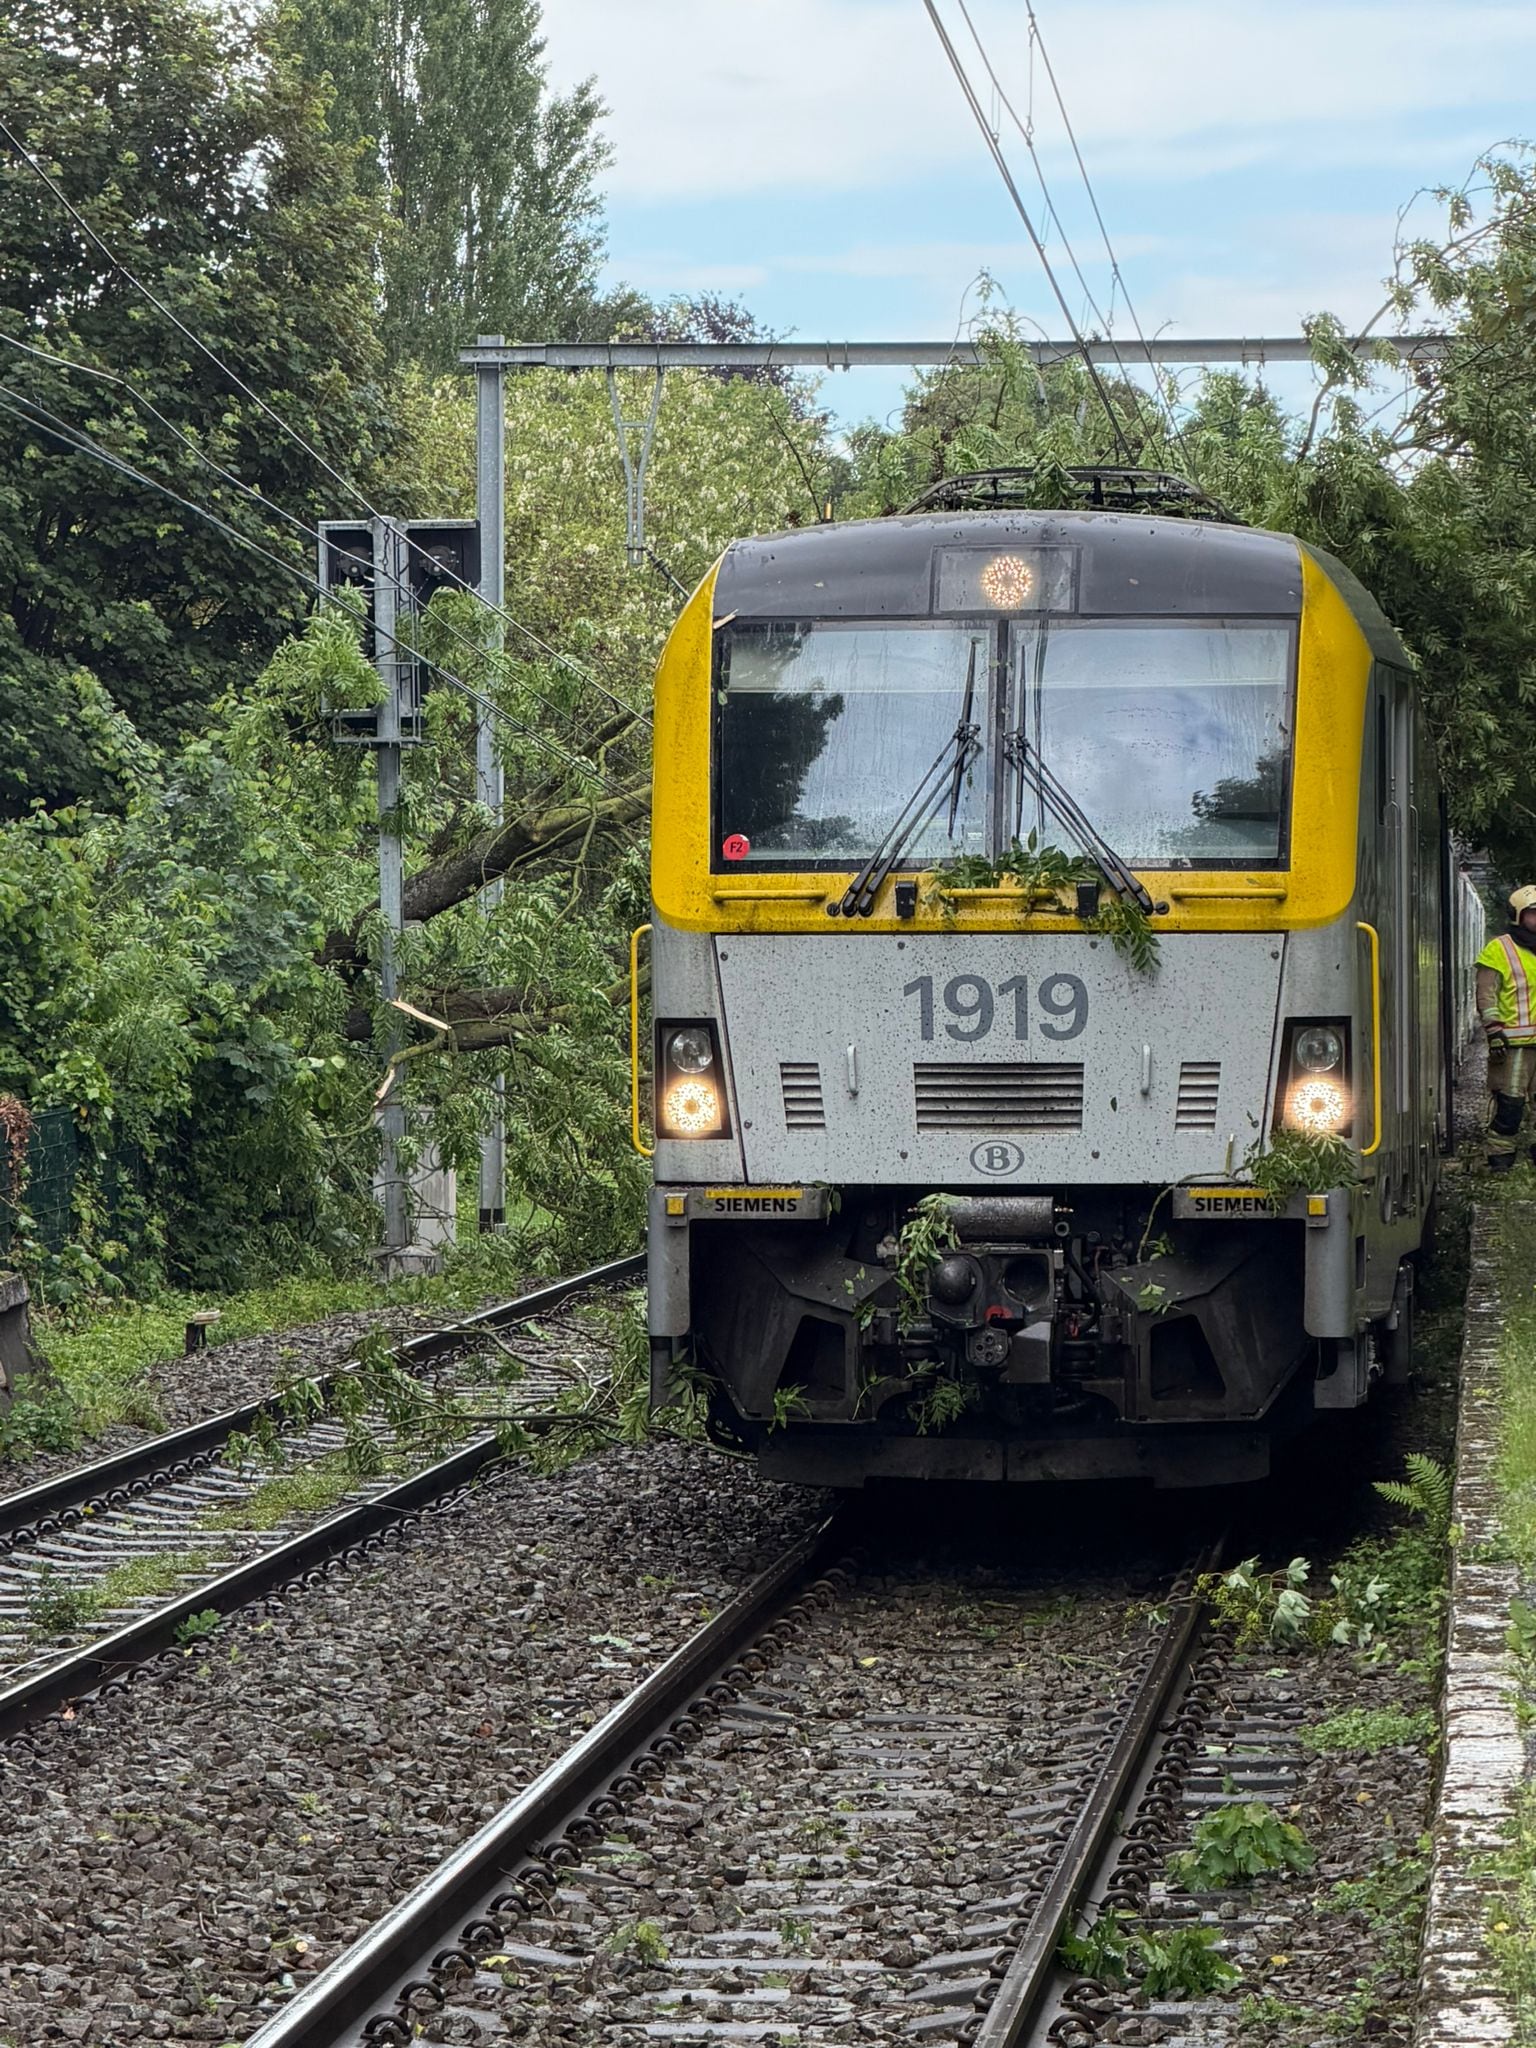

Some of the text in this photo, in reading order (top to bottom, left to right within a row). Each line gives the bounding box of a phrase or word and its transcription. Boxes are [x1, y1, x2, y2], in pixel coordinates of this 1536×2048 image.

[730, 841, 743, 853] F2
[903, 973, 1089, 1042] 1919
[984, 1145, 1011, 1171] B
[714, 1197, 797, 1213] SIEMENS
